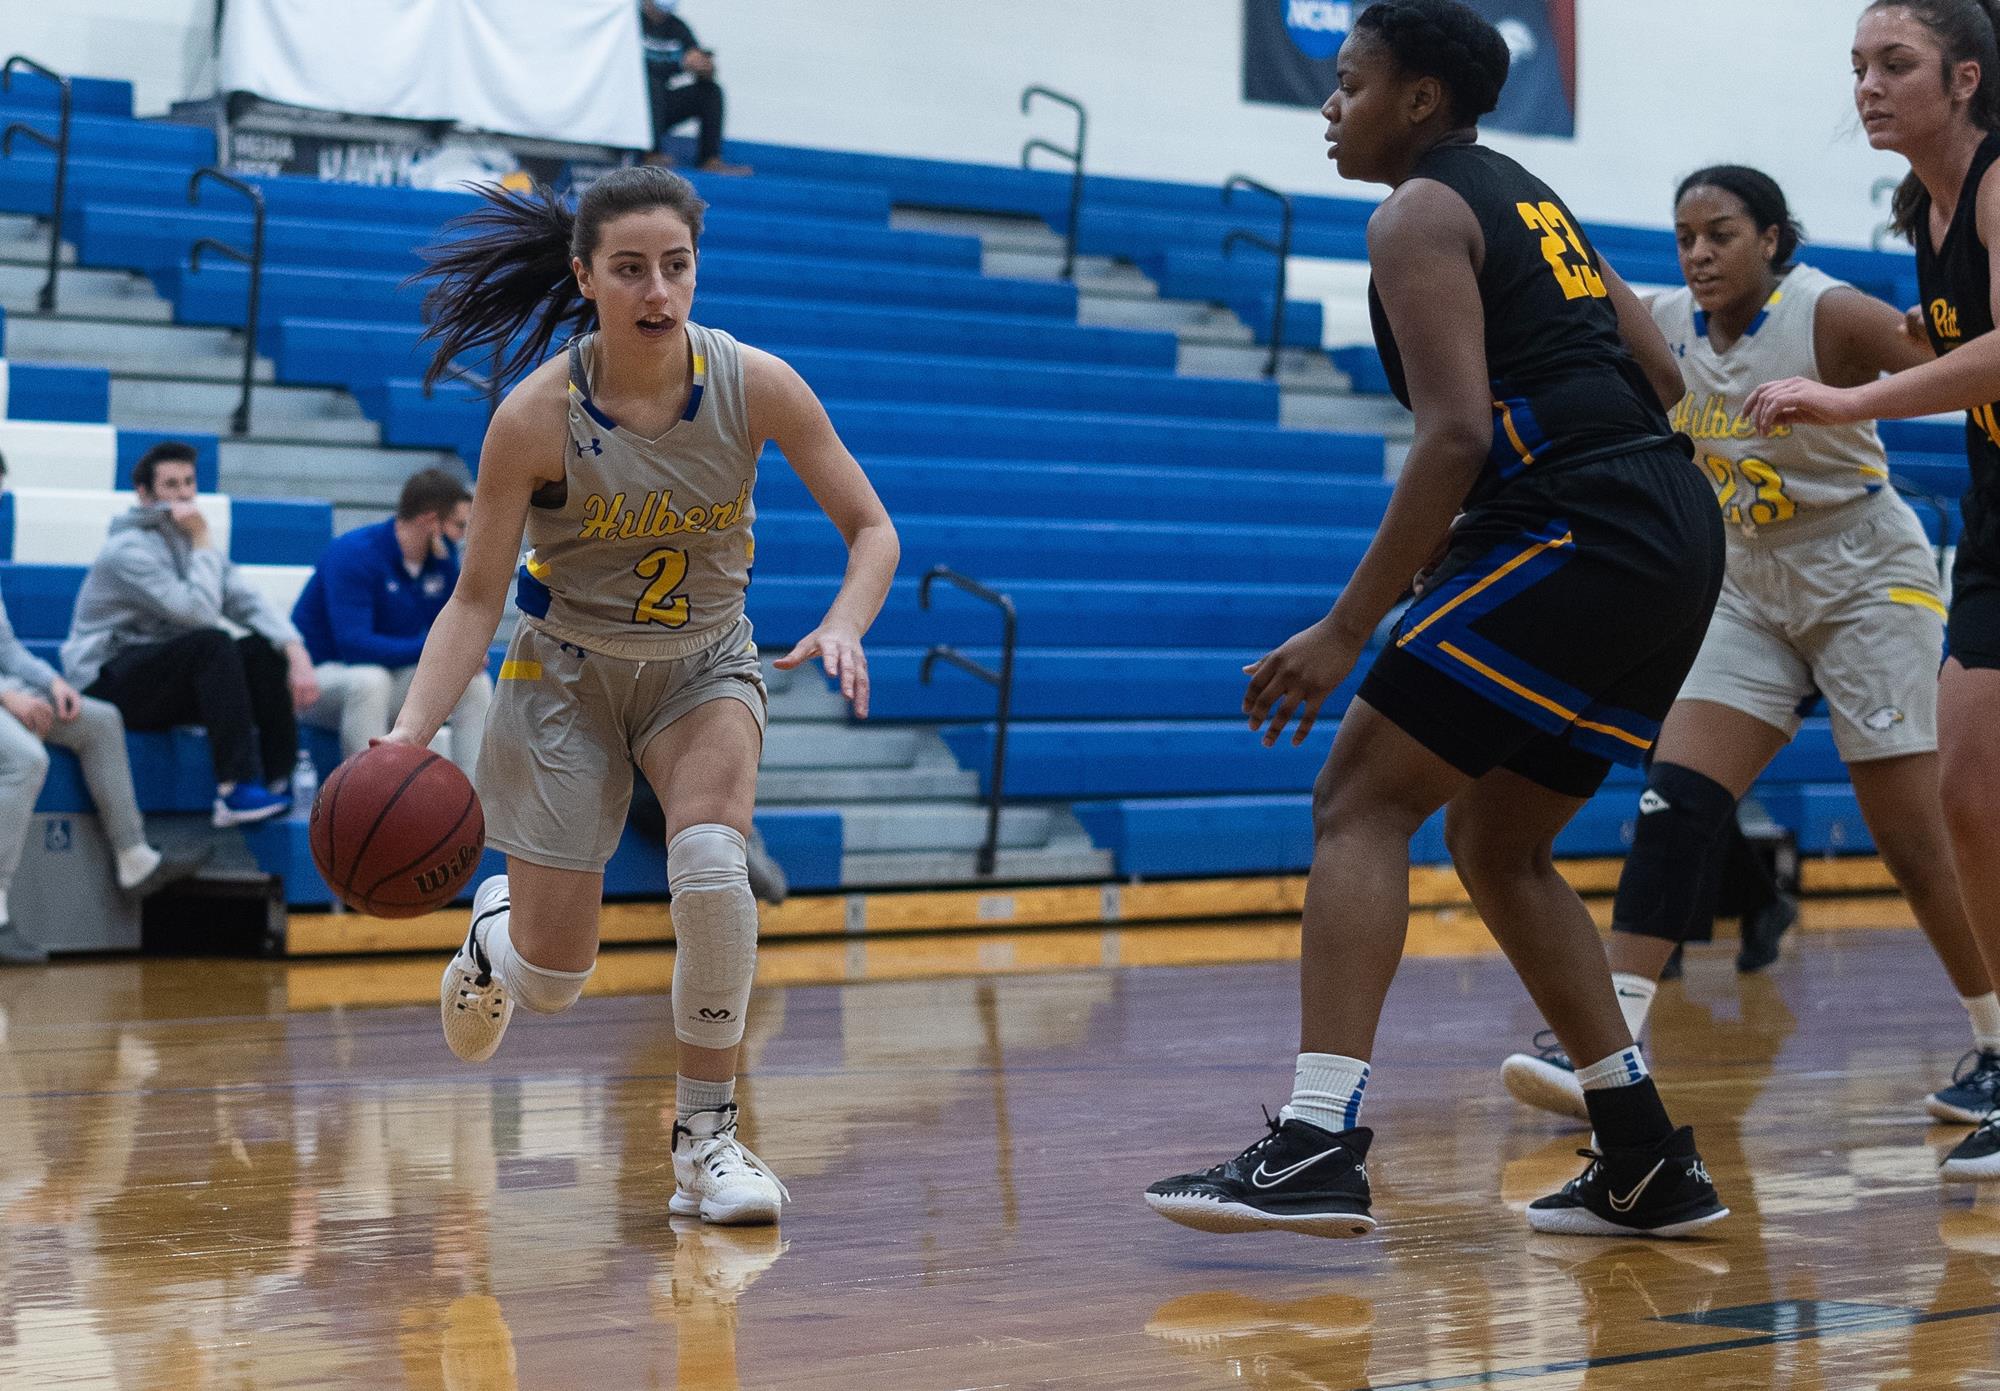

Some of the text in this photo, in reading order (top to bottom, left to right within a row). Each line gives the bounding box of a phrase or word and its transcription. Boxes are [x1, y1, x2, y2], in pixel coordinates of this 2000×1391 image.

[1515, 201, 1608, 301] 23
[1672, 391, 1793, 440] Hilbe
[578, 478, 749, 541] Hilbert
[1704, 453, 1797, 526] 23
[632, 546, 692, 629] 2
